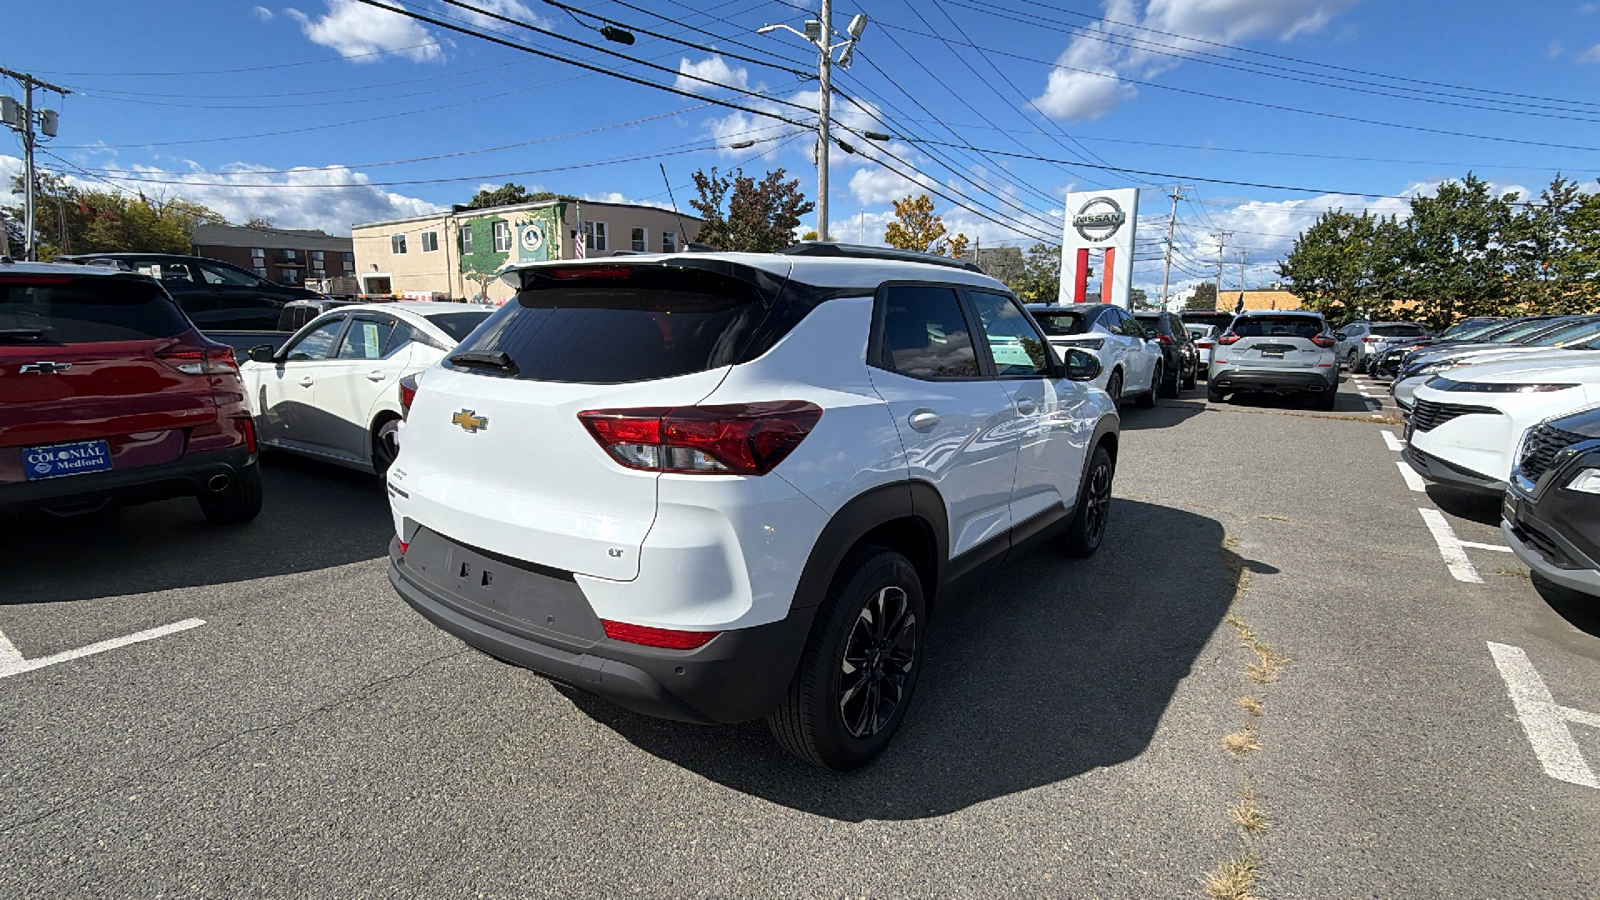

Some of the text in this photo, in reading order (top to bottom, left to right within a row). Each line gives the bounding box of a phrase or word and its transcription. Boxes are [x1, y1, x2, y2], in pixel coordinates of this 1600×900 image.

[1076, 214, 1120, 223] NISSAN
[28, 446, 105, 464] COLONIAL
[57, 458, 104, 470] Medford
[608, 547, 624, 558] LT
